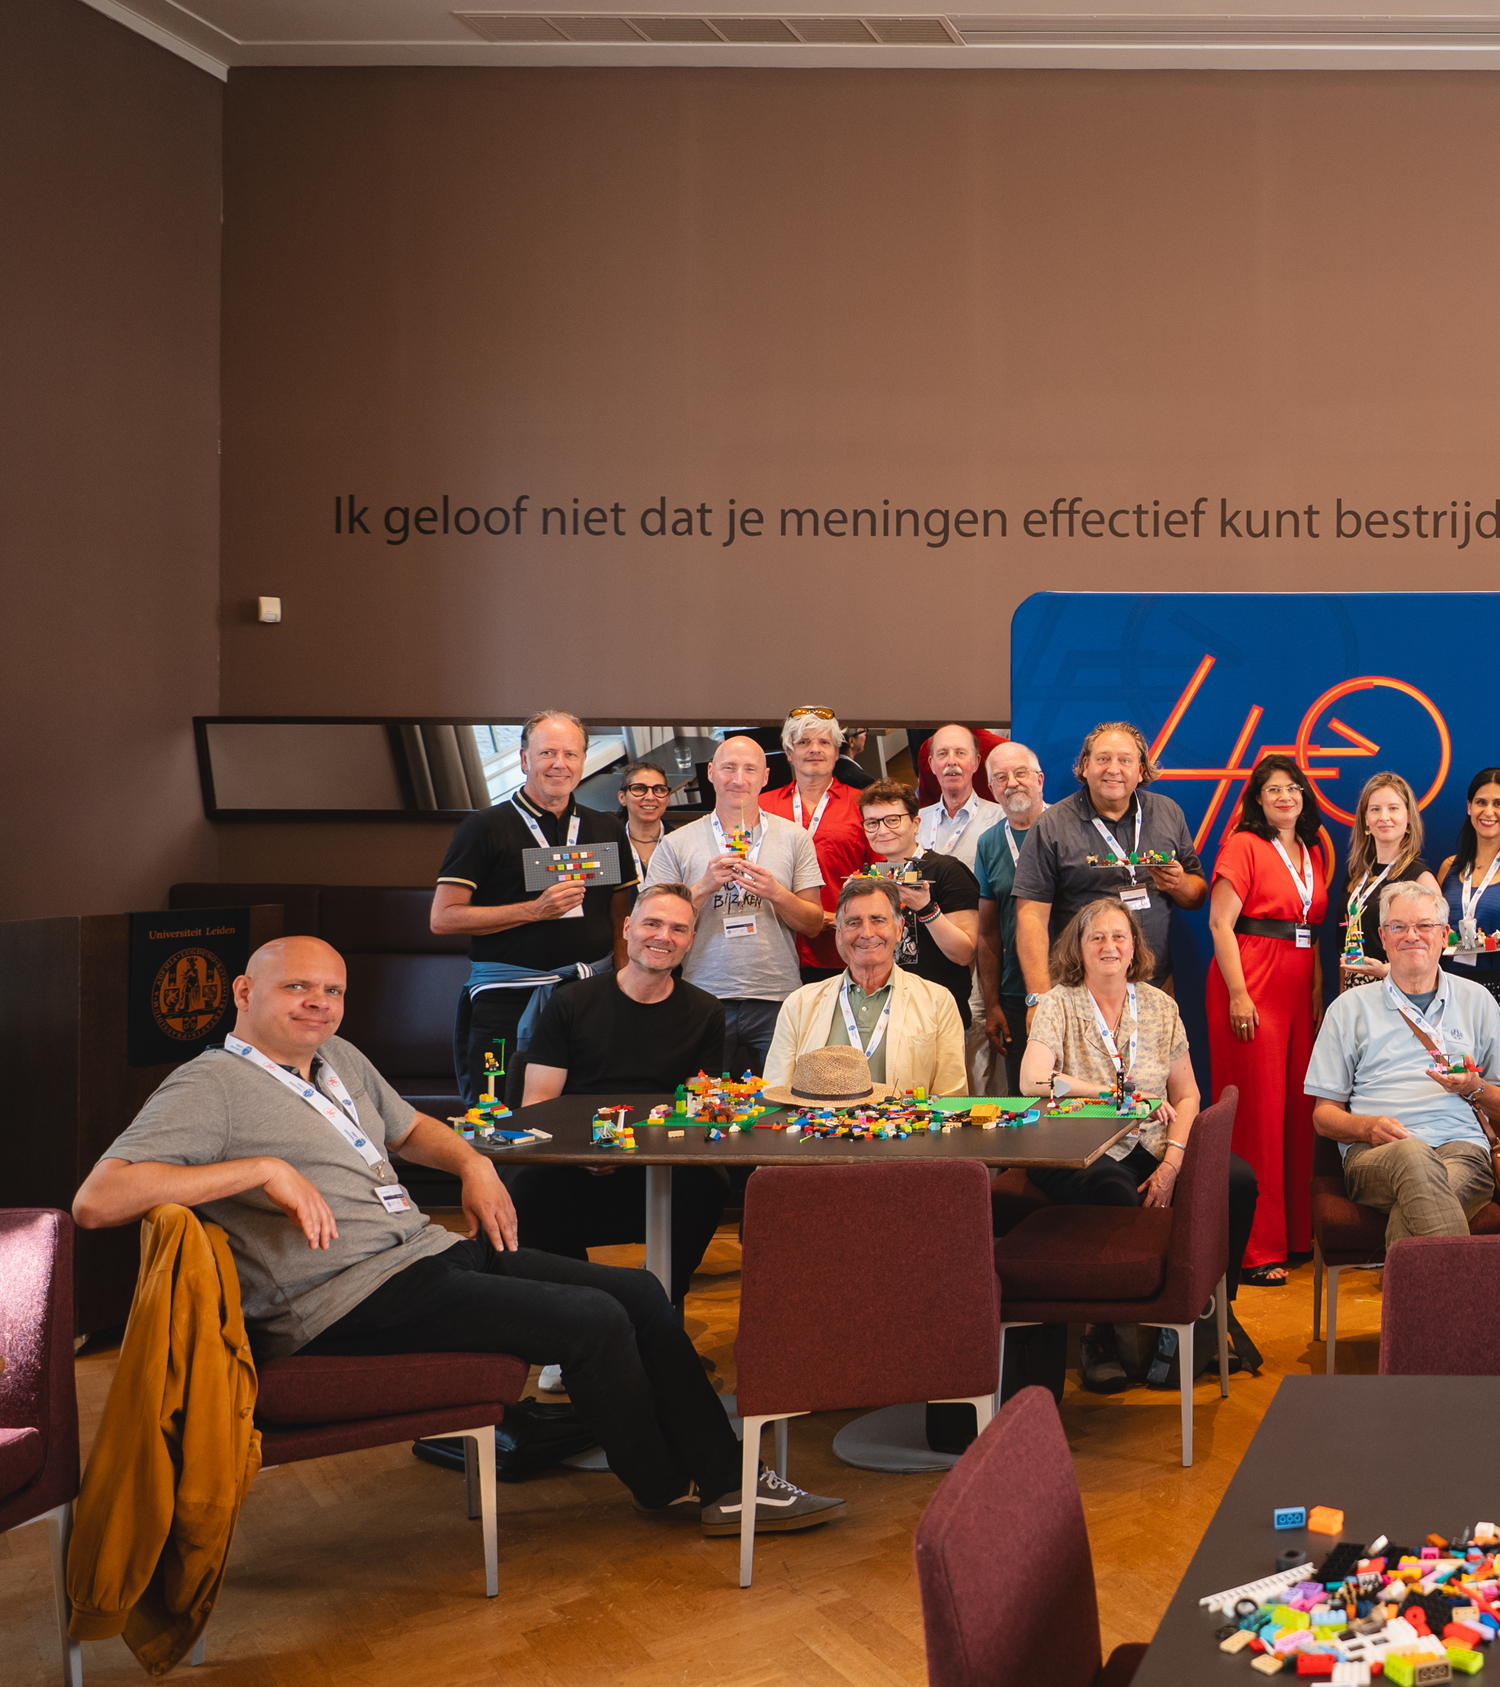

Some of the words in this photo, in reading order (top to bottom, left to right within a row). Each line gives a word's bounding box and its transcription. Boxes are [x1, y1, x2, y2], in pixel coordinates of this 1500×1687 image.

[336, 495, 371, 534] Ik
[384, 495, 530, 546] geloof
[542, 498, 627, 537] niet
[640, 496, 713, 537] dat
[722, 498, 765, 548] je
[781, 498, 1008, 549] meningen
[1023, 496, 1209, 539] effectief
[1220, 497, 1321, 539] kunt
[149, 928, 202, 939] Universiteit
[206, 926, 236, 936] Leiden
